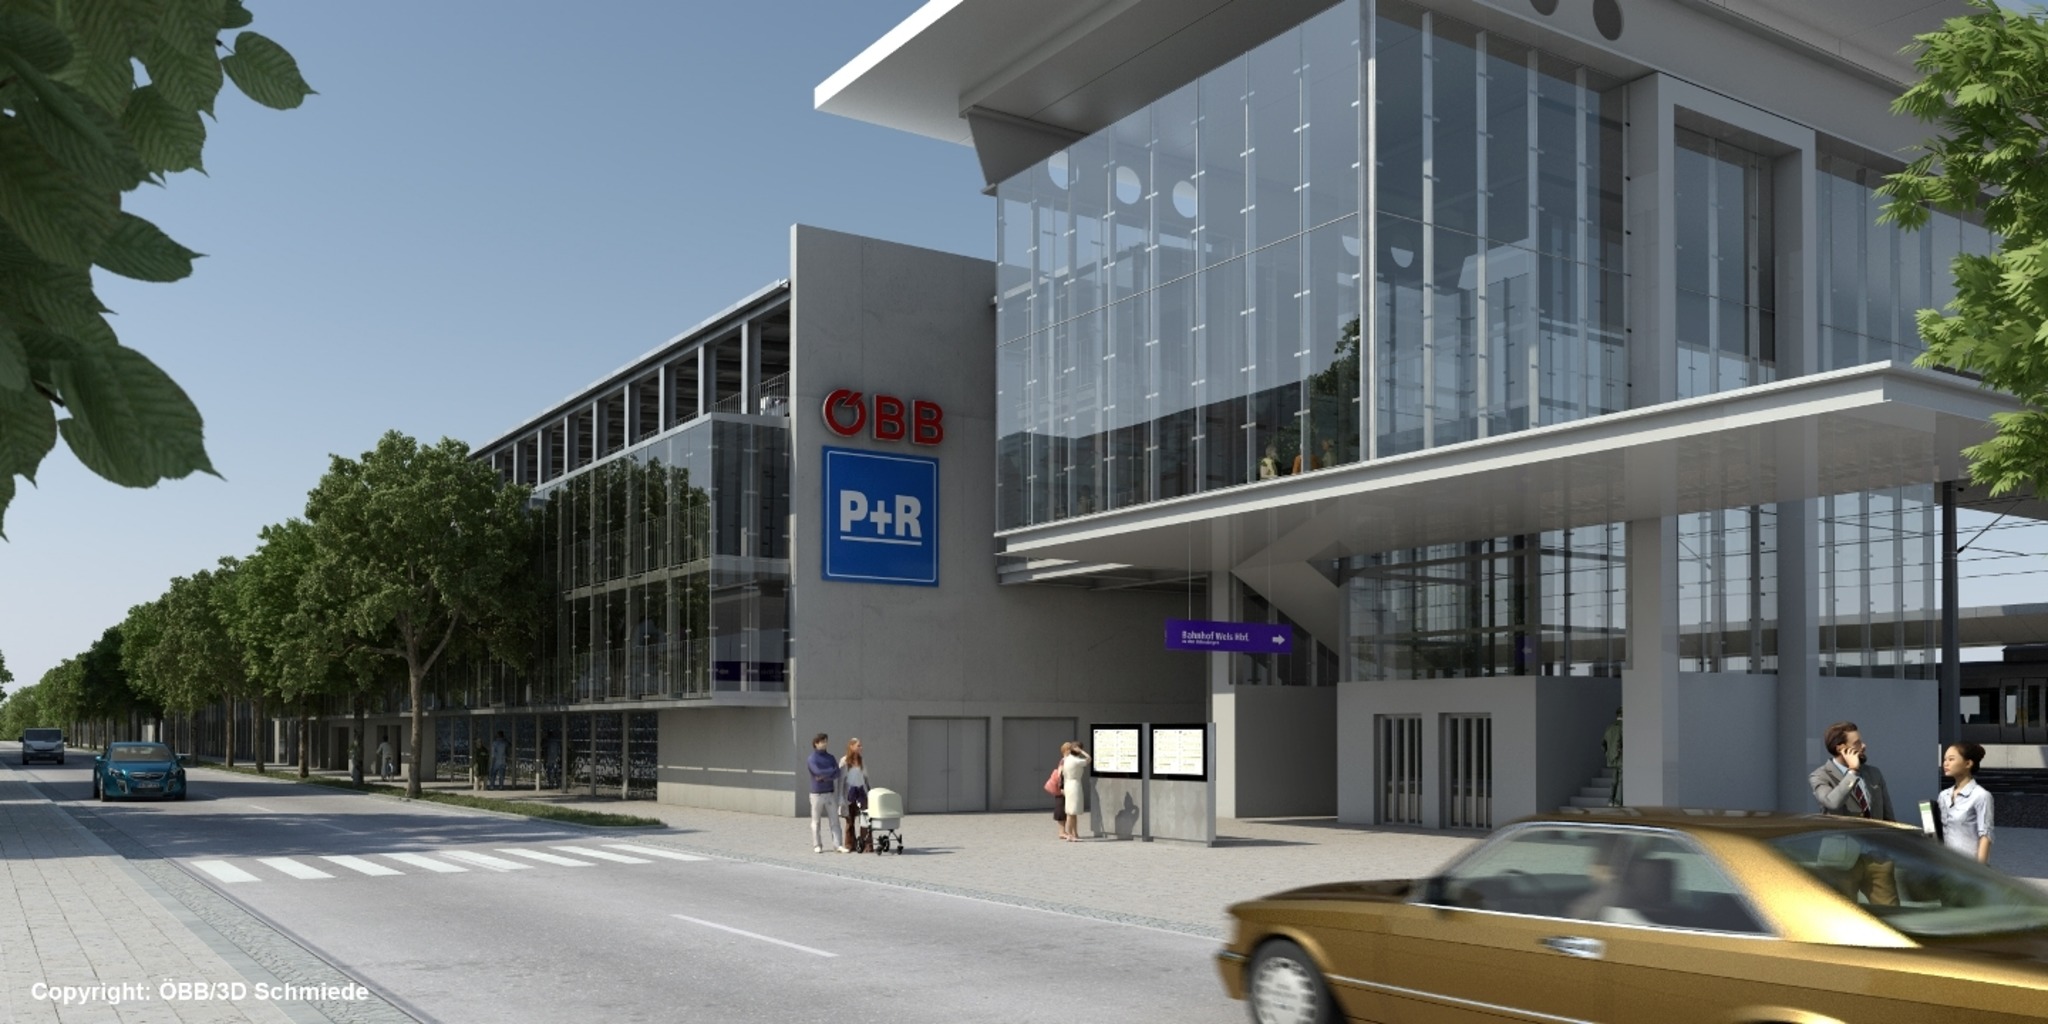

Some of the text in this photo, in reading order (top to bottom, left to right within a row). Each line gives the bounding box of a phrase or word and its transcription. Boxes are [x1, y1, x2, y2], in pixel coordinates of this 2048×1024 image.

[822, 388, 944, 446] ÖBB
[840, 489, 922, 538] P+R
[1181, 630, 1214, 640] Bahnhof
[1215, 632, 1233, 641] Wels
